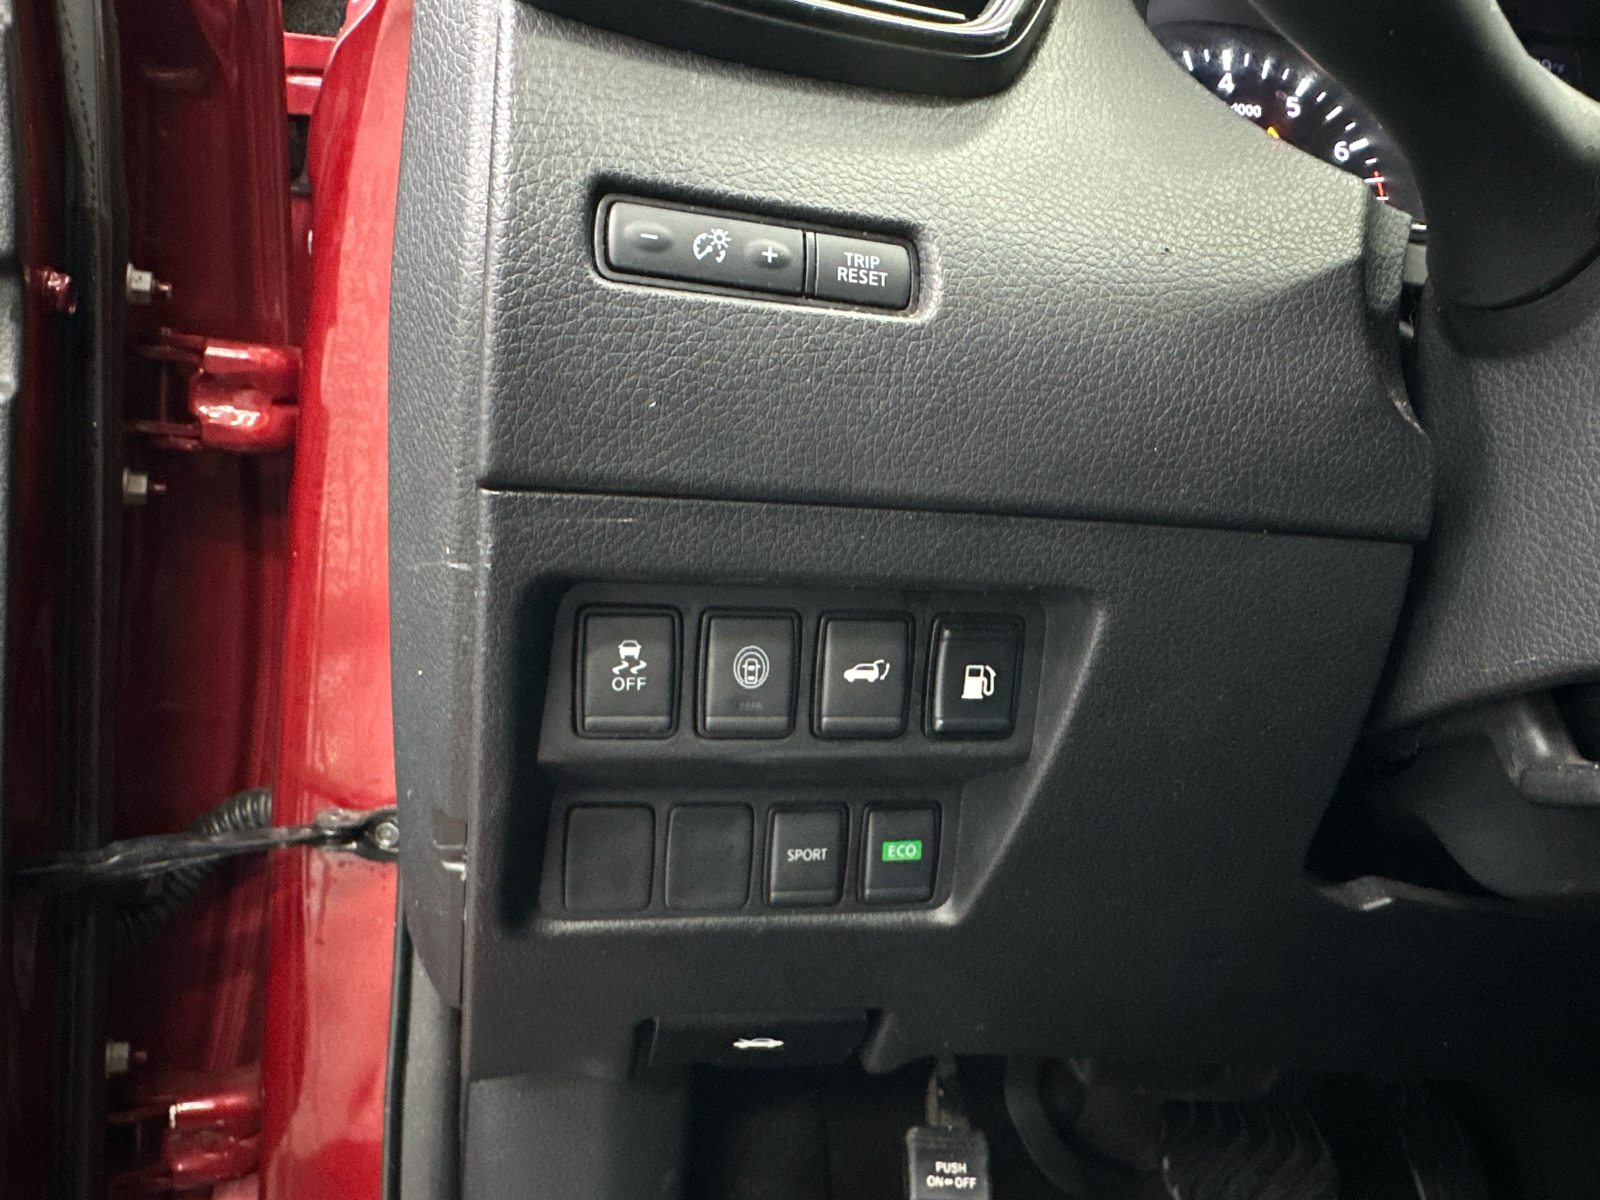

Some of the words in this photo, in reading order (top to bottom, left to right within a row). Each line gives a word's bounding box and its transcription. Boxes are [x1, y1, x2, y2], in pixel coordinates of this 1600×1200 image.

[1217, 72, 1235, 94] 4
[1230, 101, 1262, 118] 1000
[1285, 96, 1301, 118] 5
[1333, 140, 1349, 161] 6
[843, 251, 881, 270] TRIP
[837, 266, 888, 288] RESET
[611, 675, 647, 692] OFF
[787, 846, 828, 862] SPORT
[887, 842, 917, 859] ECO
[935, 1160, 968, 1175] PUSH
